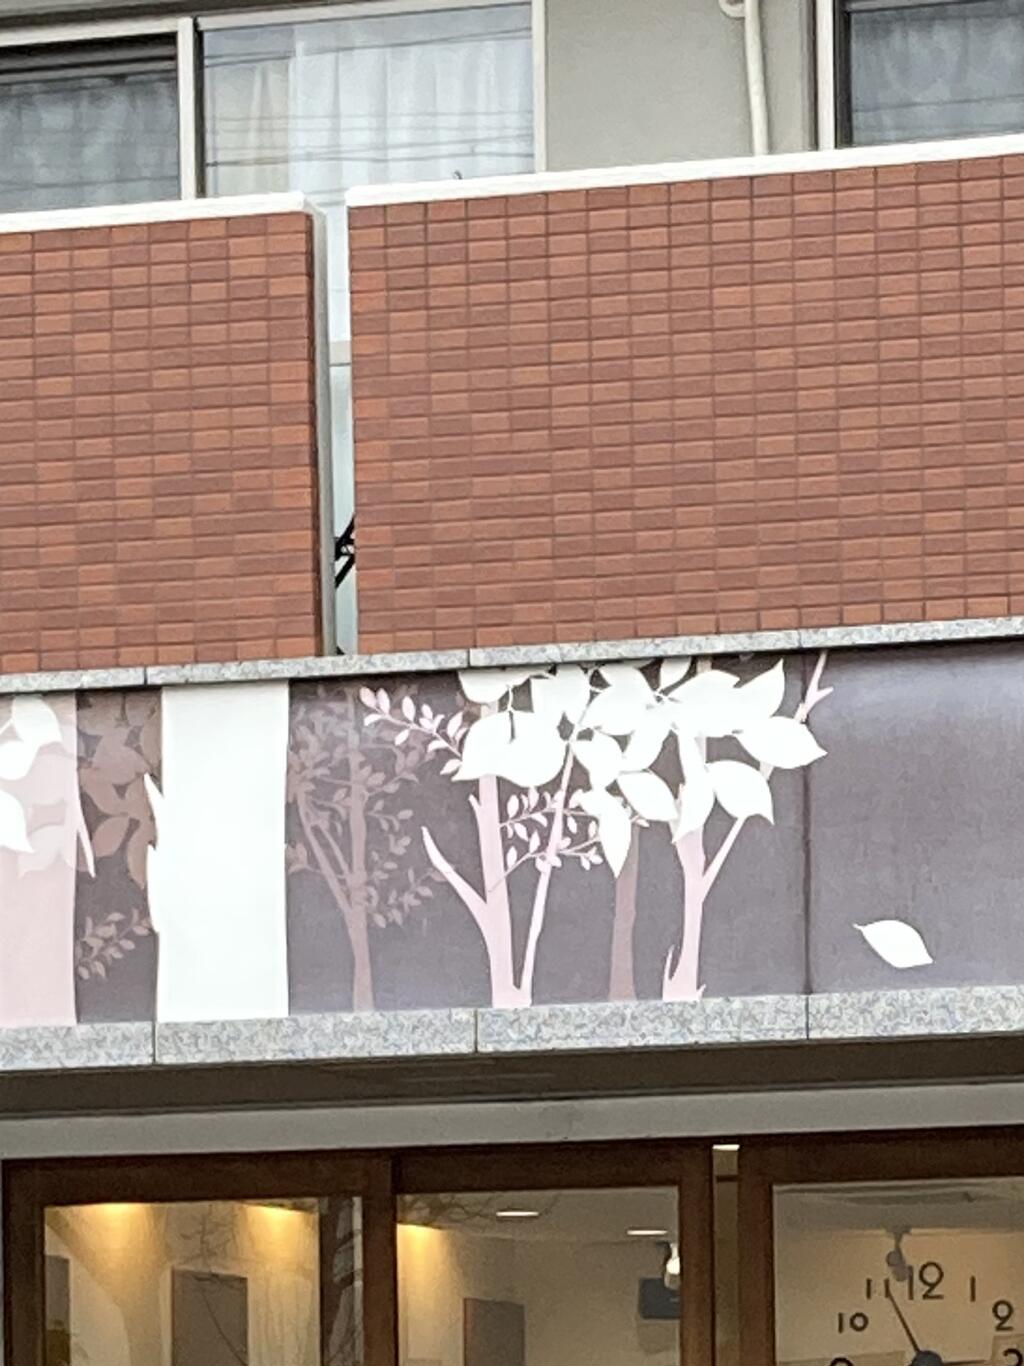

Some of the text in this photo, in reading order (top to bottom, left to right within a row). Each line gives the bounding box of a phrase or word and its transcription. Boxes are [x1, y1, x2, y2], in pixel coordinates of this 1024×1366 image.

[866, 1278, 891, 1299] 11
[908, 1262, 944, 1300] 12
[970, 1275, 976, 1302] 1
[838, 1312, 869, 1333] 10
[992, 1300, 1014, 1331] 2
